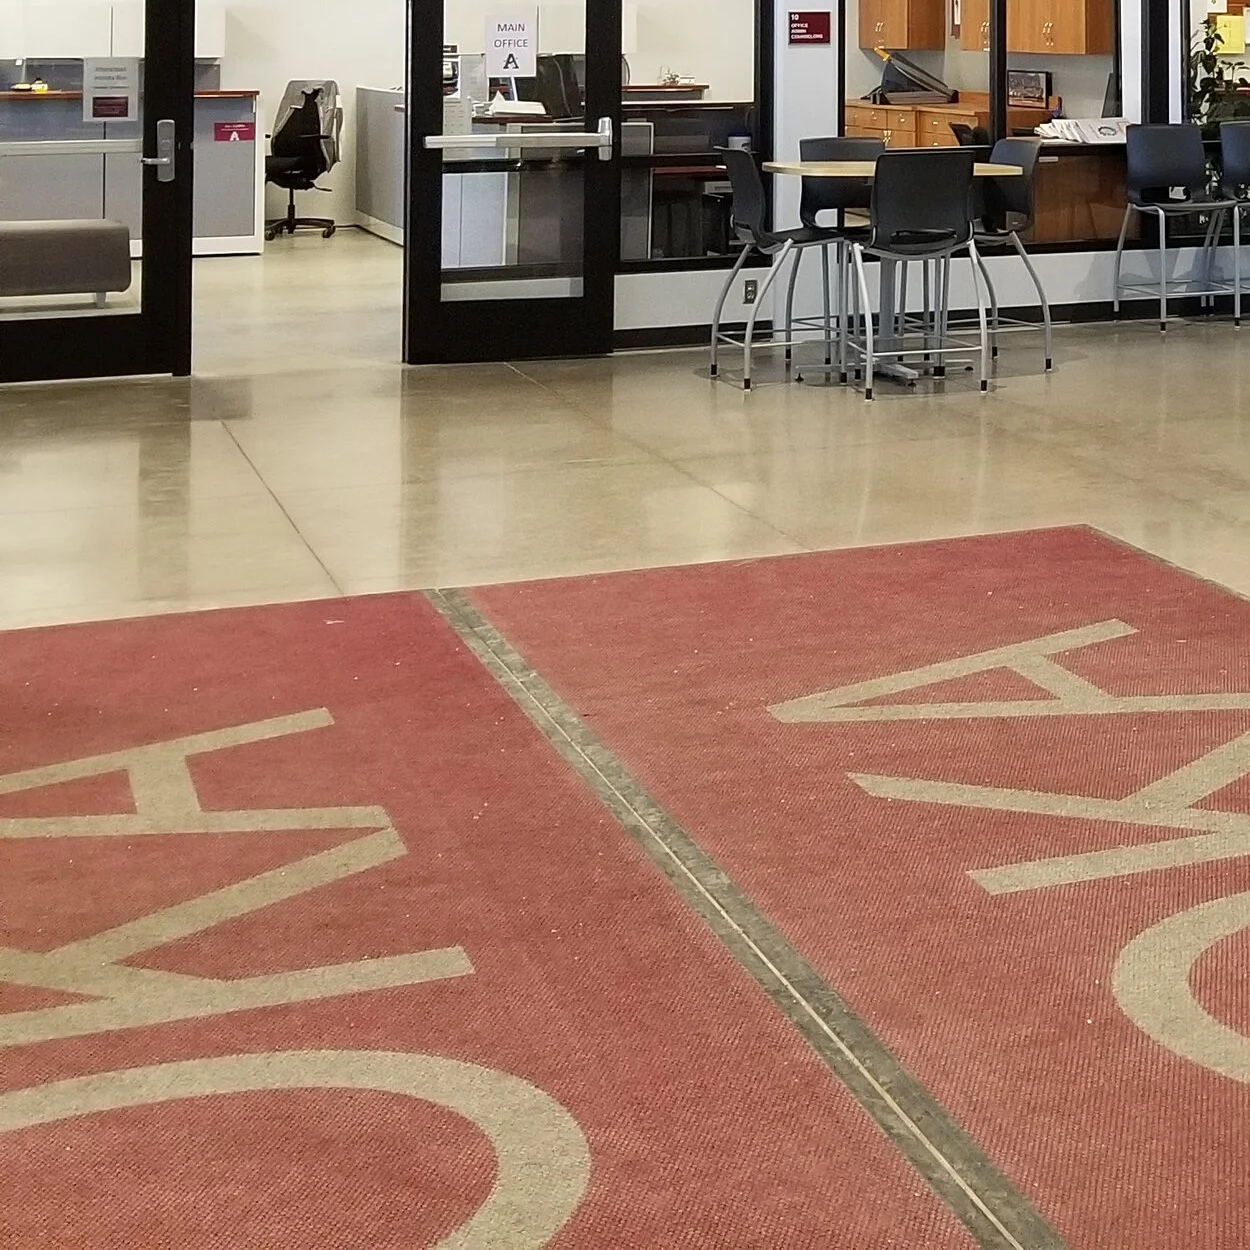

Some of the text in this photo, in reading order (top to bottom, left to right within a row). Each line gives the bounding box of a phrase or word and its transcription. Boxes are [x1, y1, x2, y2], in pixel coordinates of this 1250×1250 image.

[791, 13, 799, 21] 10
[497, 23, 525, 32] MAIN
[494, 39, 528, 48] OFFICE
[503, 53, 519, 69] A
[229, 131, 240, 141] A
